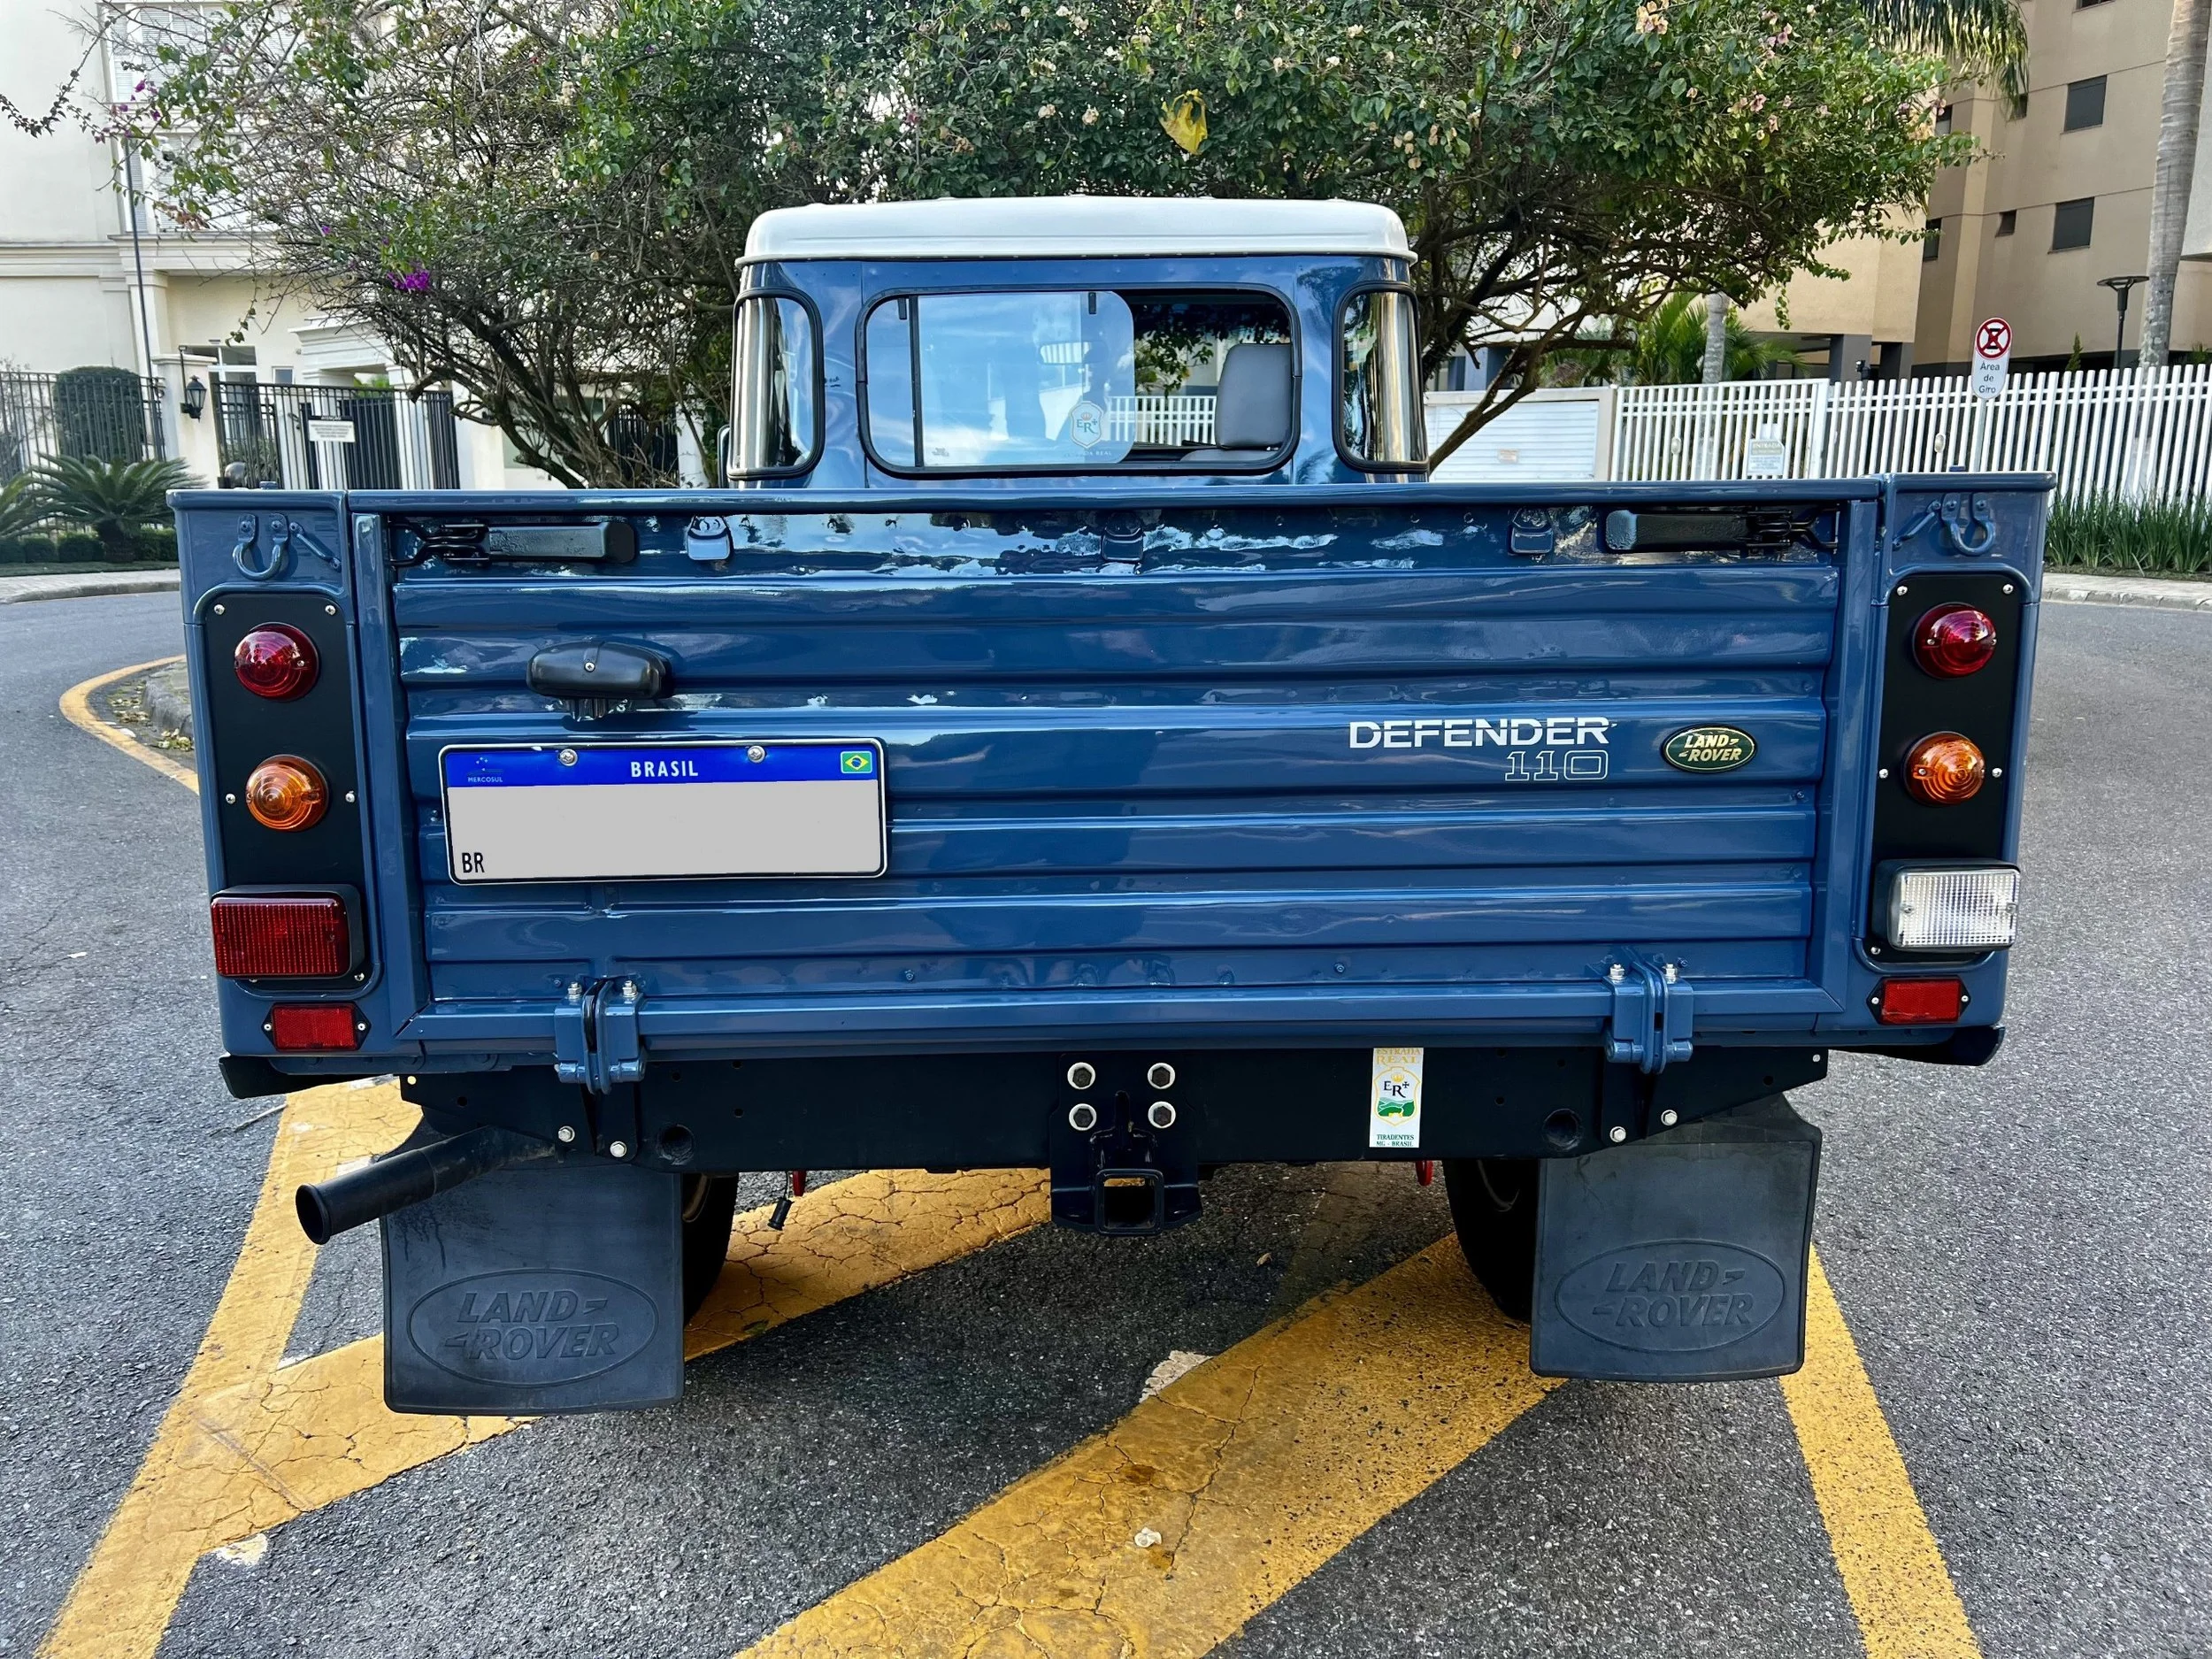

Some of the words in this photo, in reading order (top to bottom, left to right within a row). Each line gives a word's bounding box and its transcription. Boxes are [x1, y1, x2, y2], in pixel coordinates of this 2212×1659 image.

[1980, 360, 2001, 371] Área
[1978, 385, 1996, 394] Giro
[1348, 716, 1610, 749] DEFENDER
[1684, 733, 1730, 749] LAND
[1504, 749, 1609, 781] 110
[1687, 748, 1742, 762] ROVER
[630, 760, 699, 779] BRASIL
[461, 852, 485, 874] BR
[1604, 1259, 1719, 1292] LAND
[457, 1290, 579, 1324] LAND
[1616, 1294, 1755, 1327] ROVER
[468, 1324, 619, 1361] ROVER
